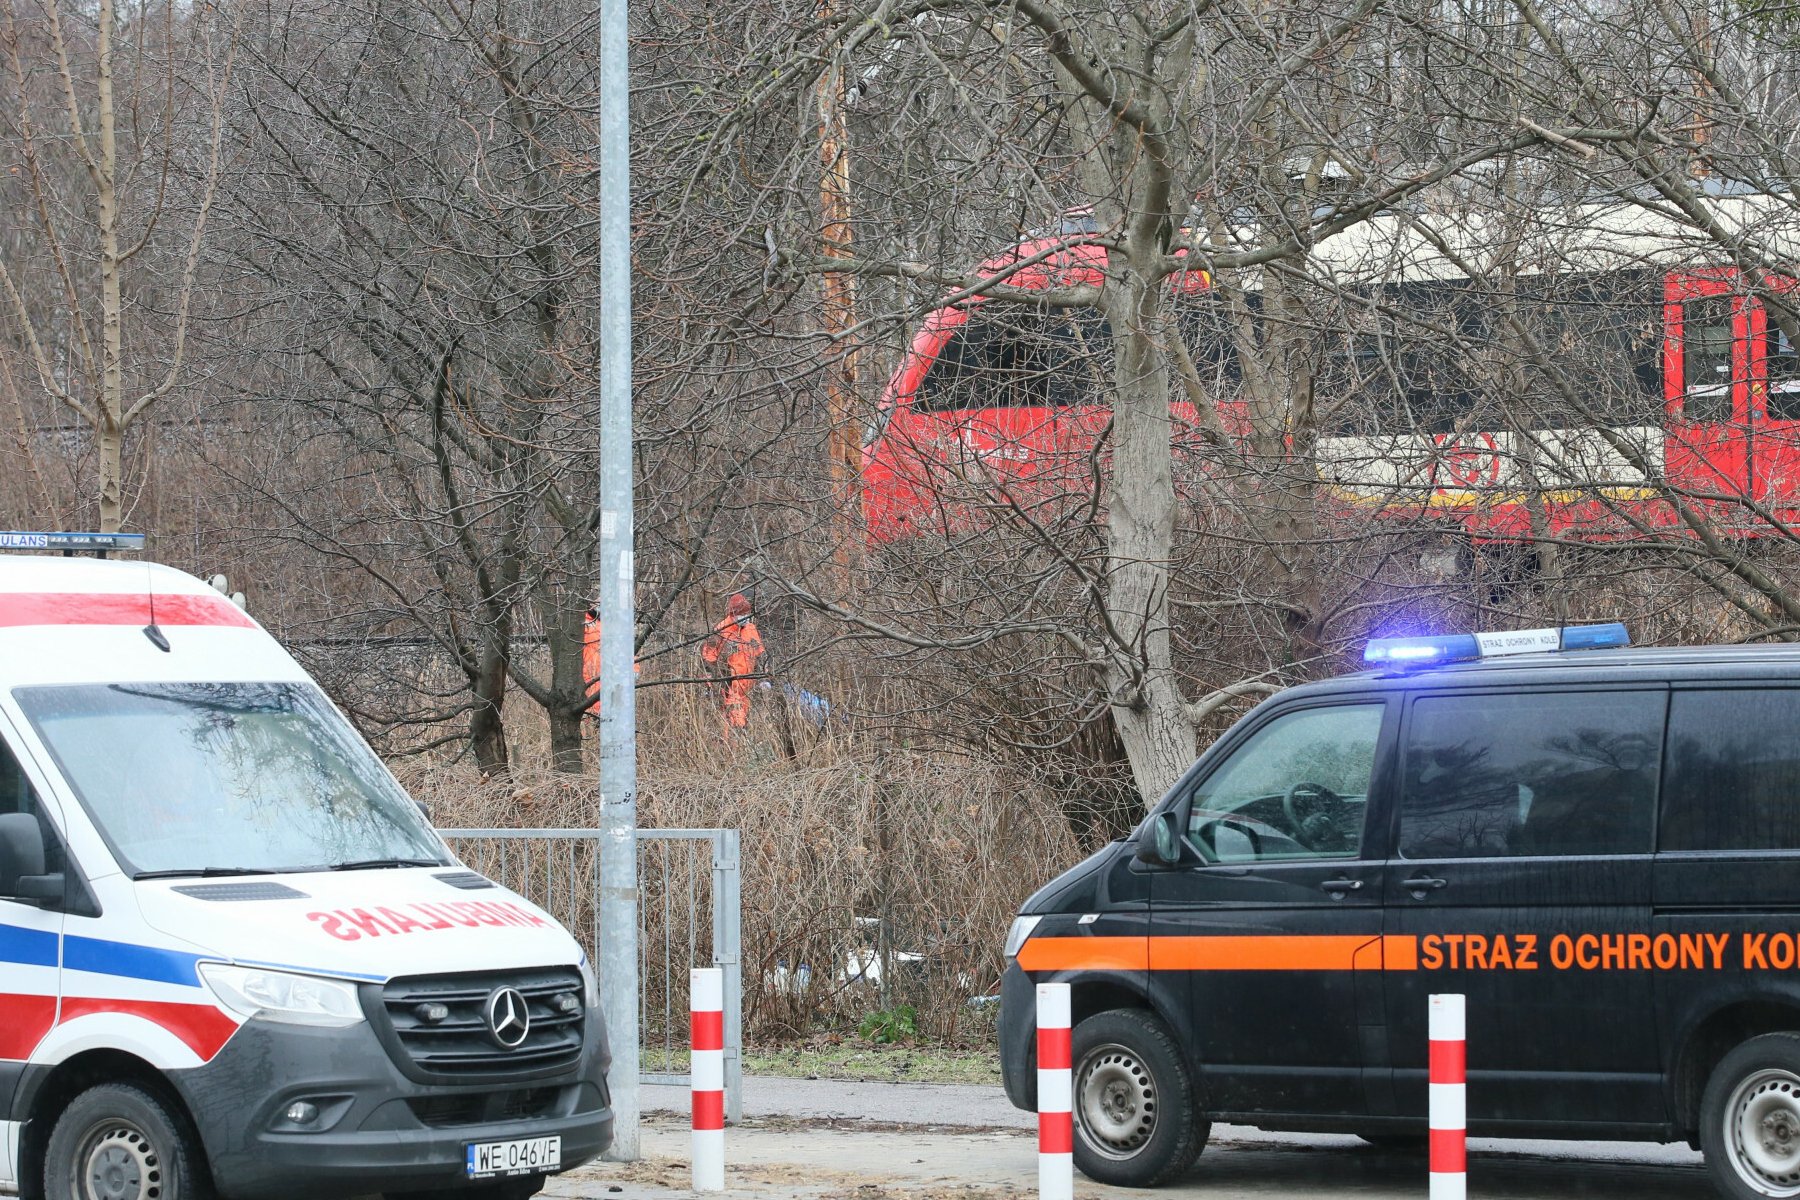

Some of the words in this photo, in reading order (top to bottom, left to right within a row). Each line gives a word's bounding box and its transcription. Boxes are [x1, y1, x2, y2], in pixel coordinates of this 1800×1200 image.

[1550, 933, 1730, 970] OCHRONY
[1743, 932, 1800, 970] KO
[480, 1145, 502, 1170] WE
[509, 1140, 557, 1167] 046VF
